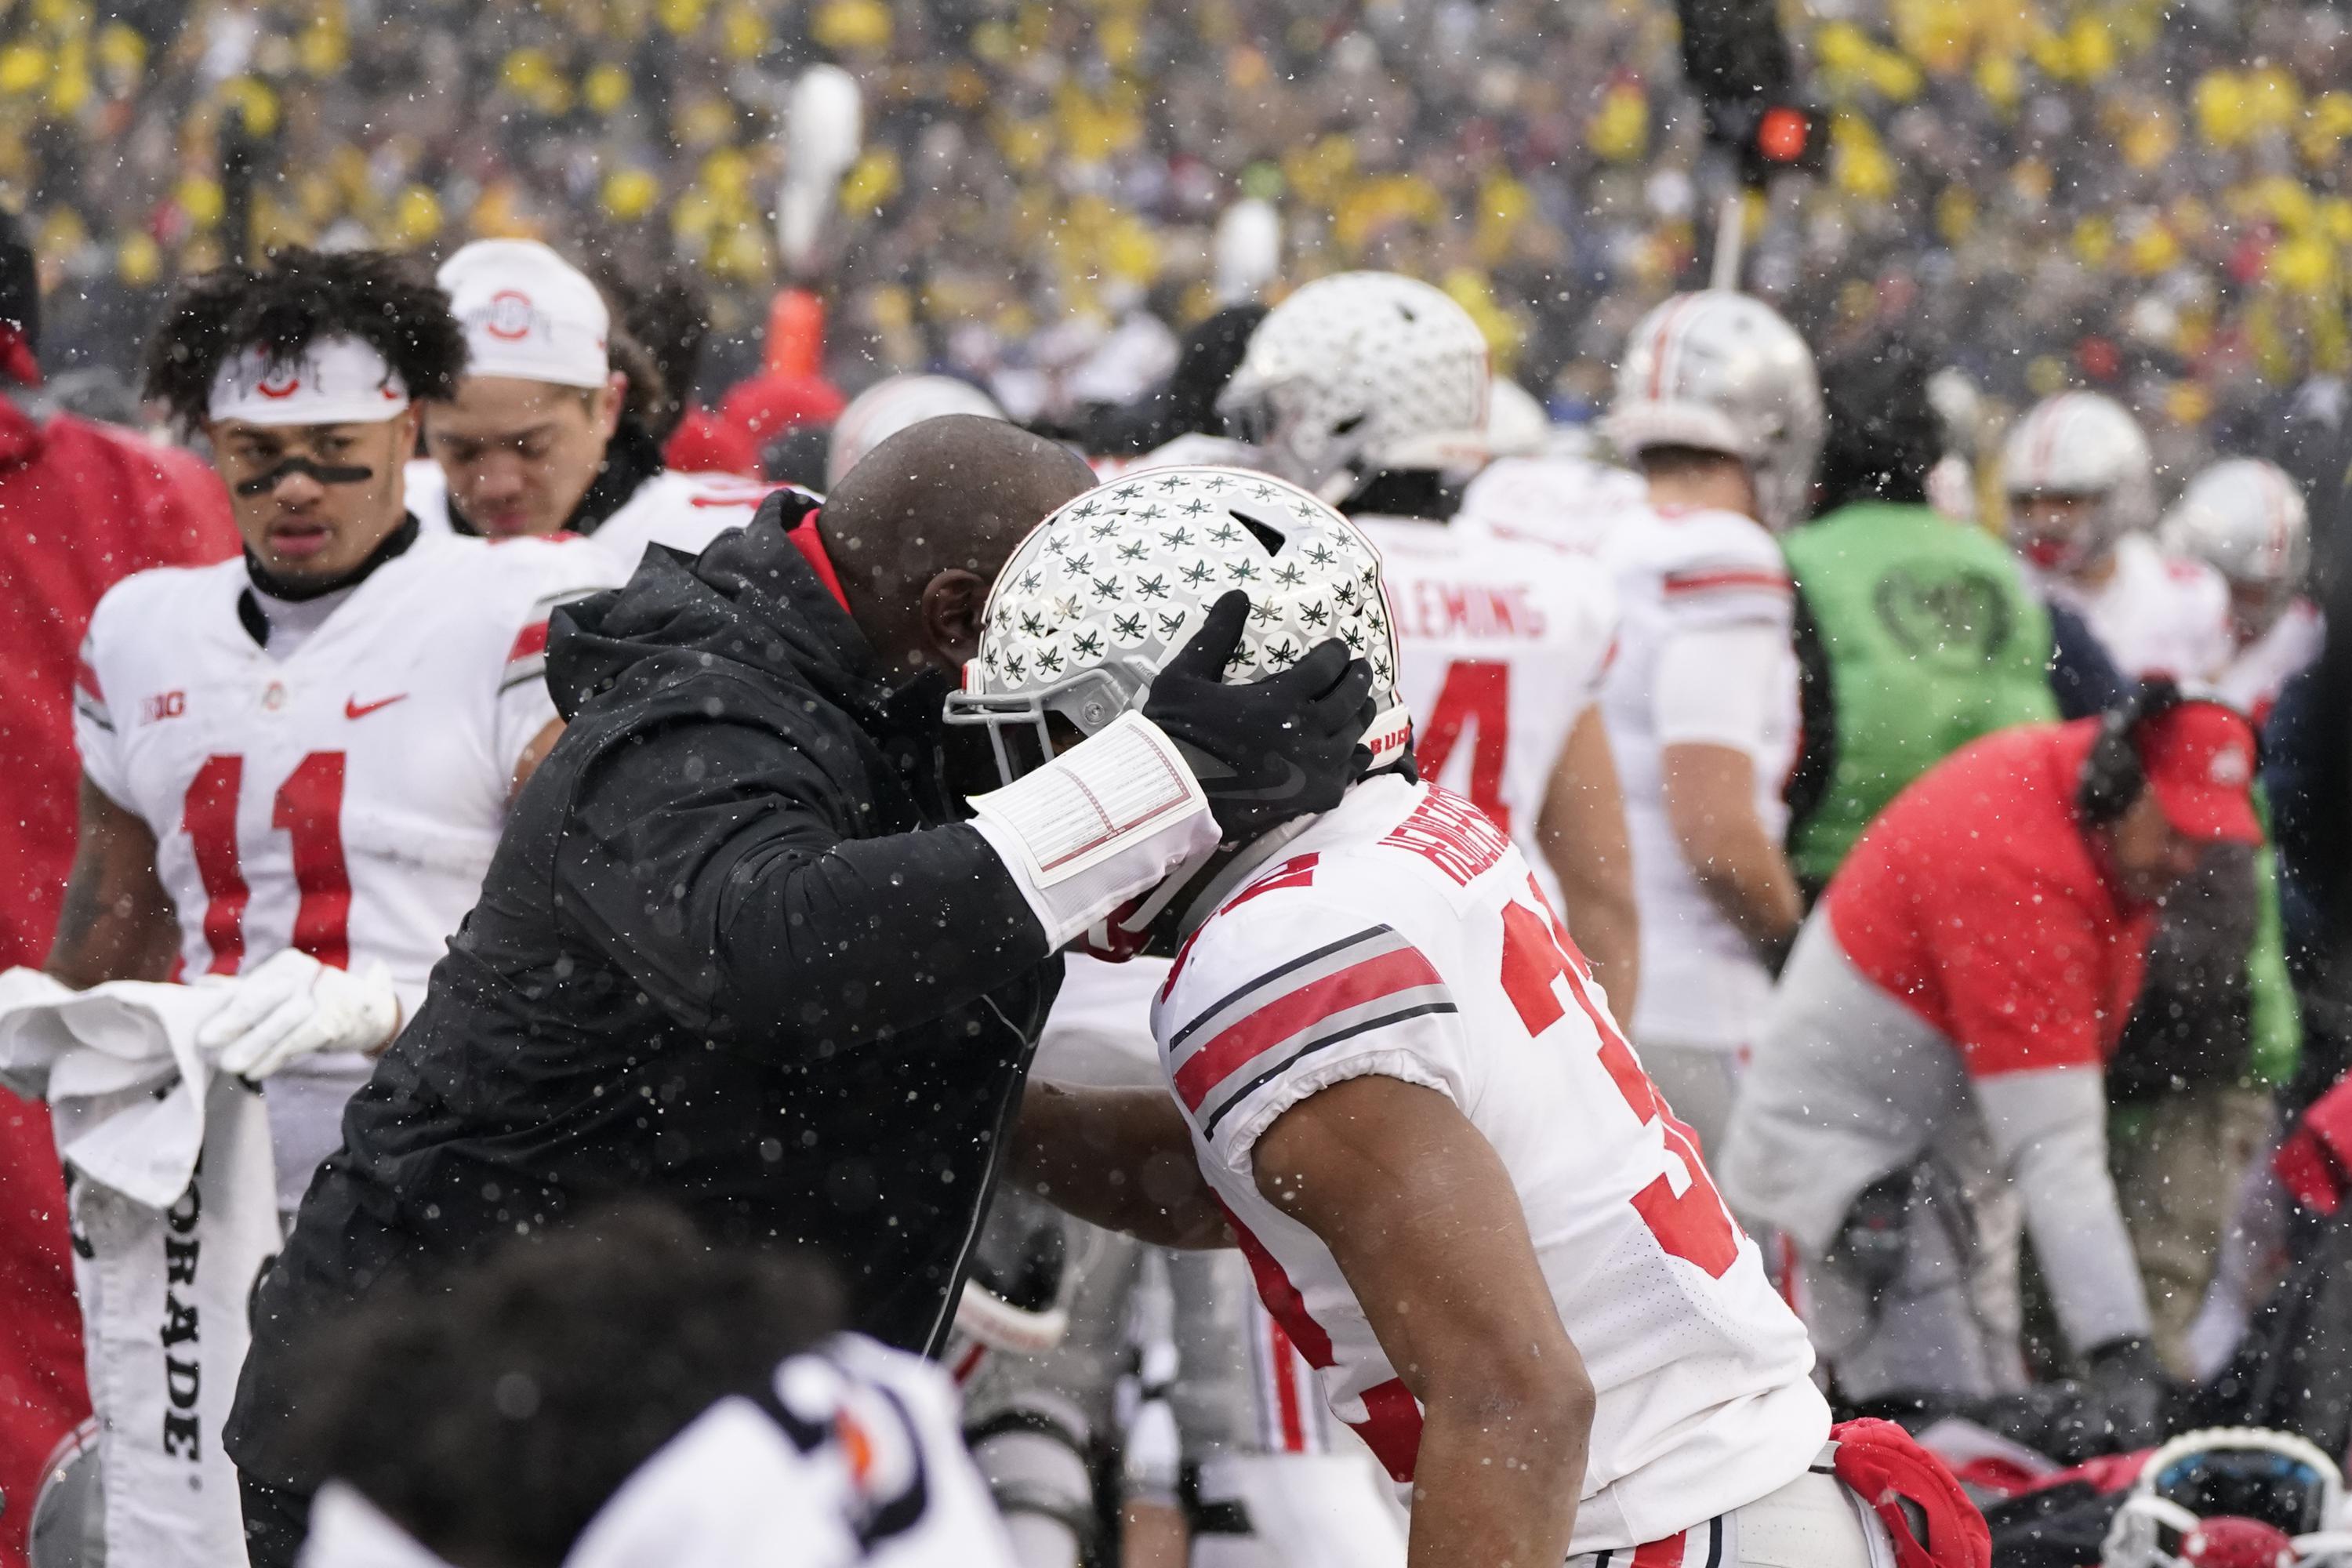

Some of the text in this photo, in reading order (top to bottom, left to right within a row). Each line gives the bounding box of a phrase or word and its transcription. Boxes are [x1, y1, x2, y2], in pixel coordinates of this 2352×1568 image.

[1386, 579, 1547, 640] LEMING
[179, 750, 351, 977] 11
[1376, 782, 1510, 887] HENDERS
[160, 1151, 202, 1465] ORADE
